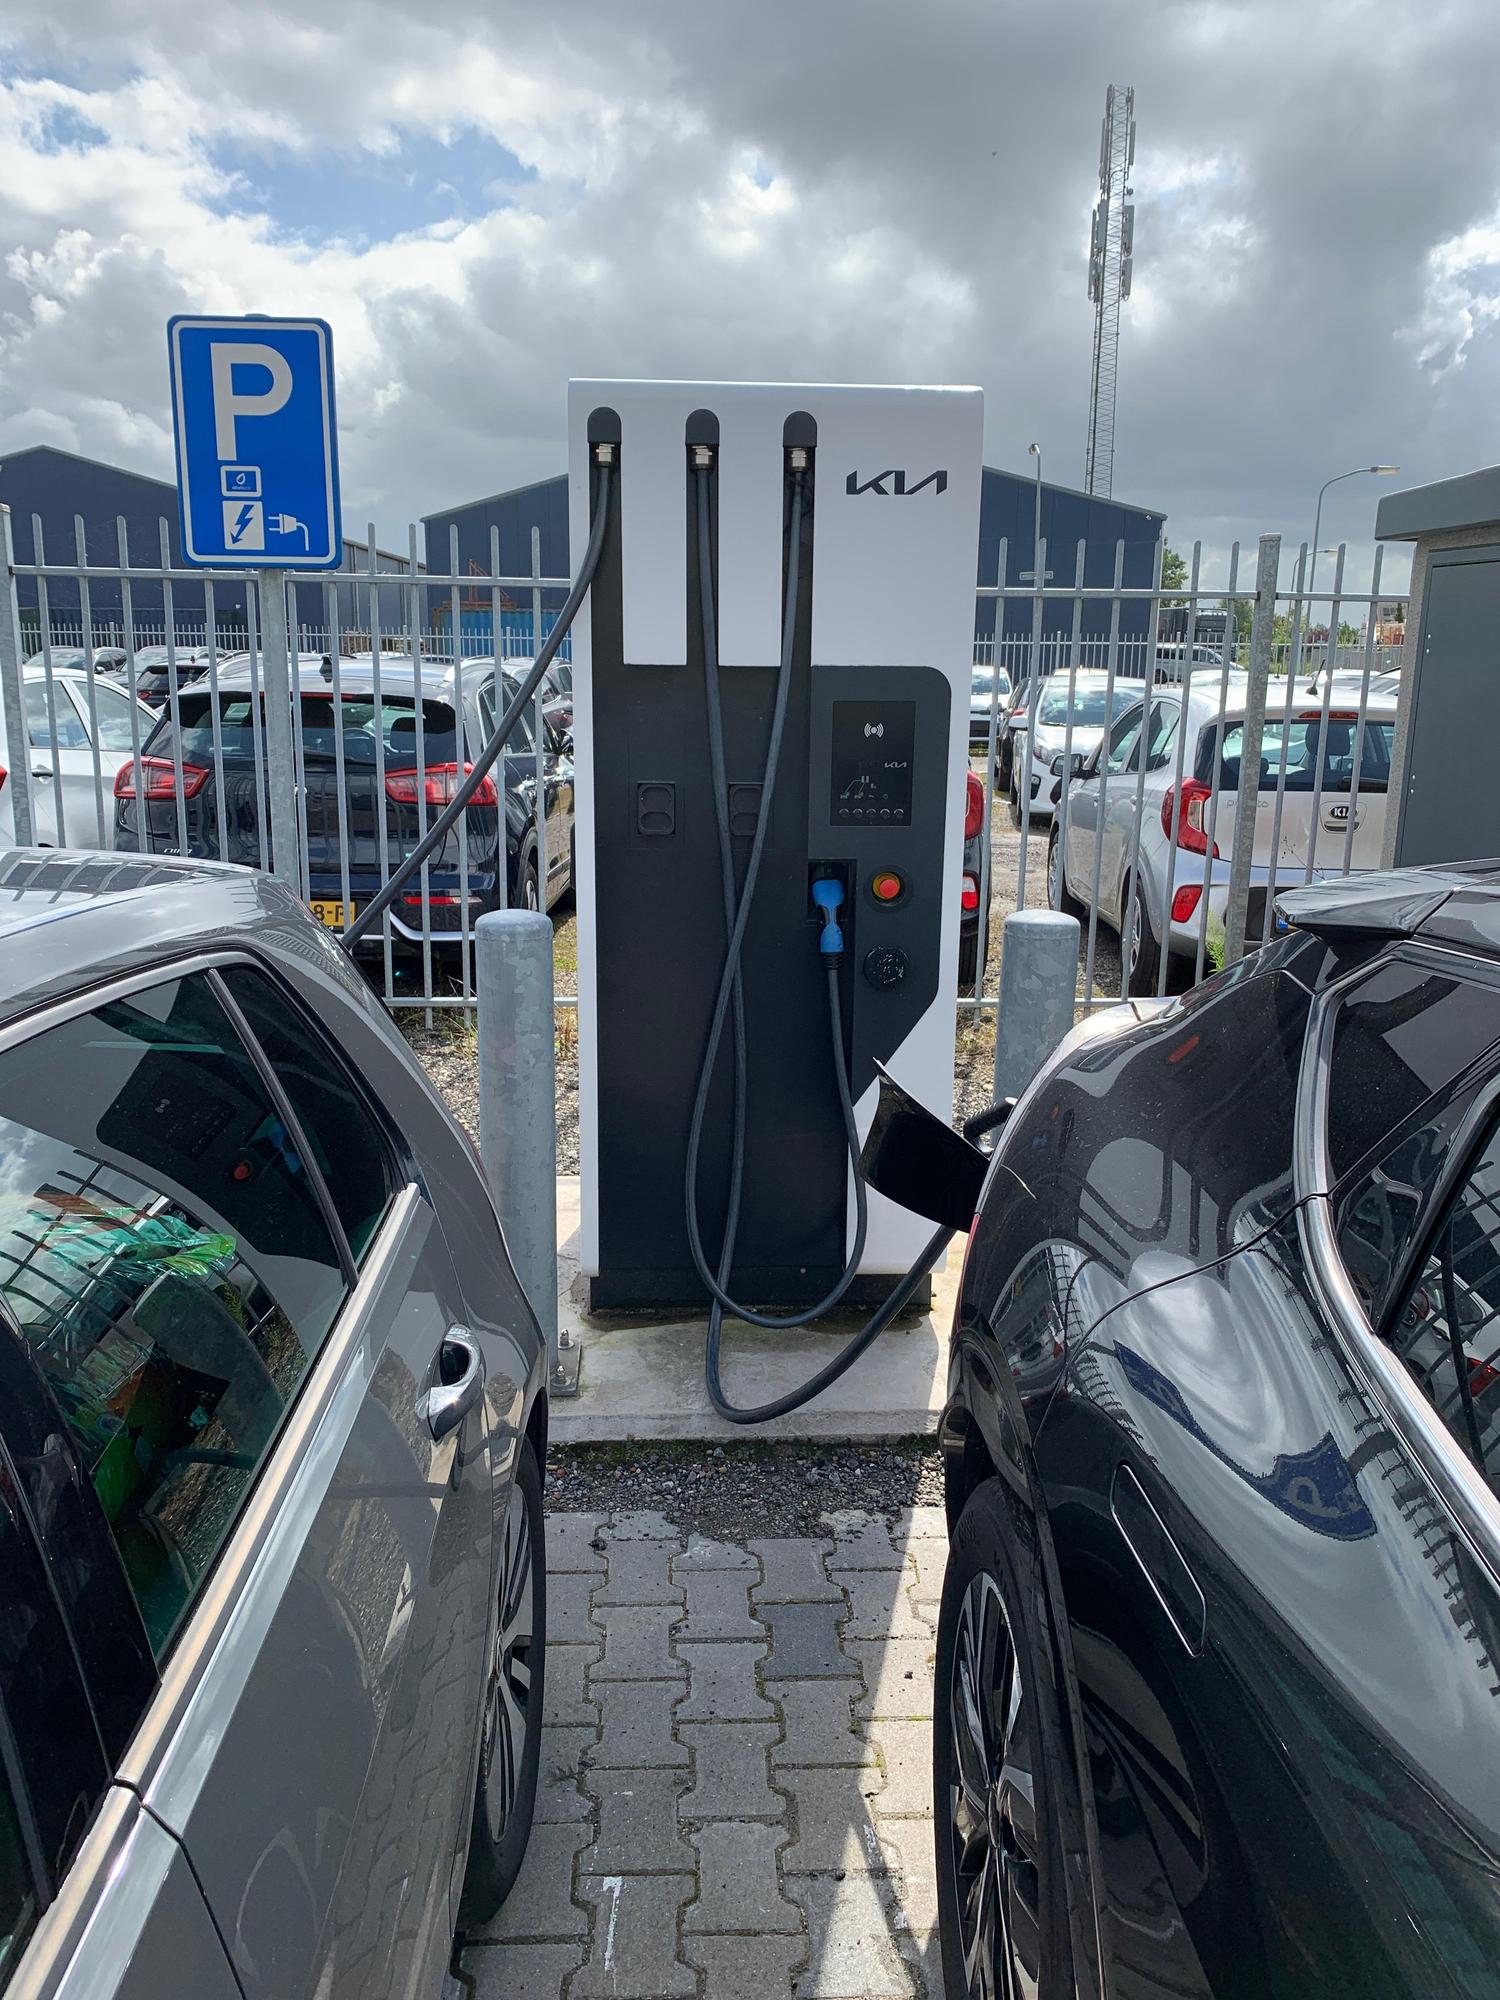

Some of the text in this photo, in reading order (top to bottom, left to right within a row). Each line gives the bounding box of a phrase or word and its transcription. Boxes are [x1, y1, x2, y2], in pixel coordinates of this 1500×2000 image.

[210, 342, 293, 461] P
[846, 470, 947, 495] KIA
[1334, 808, 1355, 816] KI
